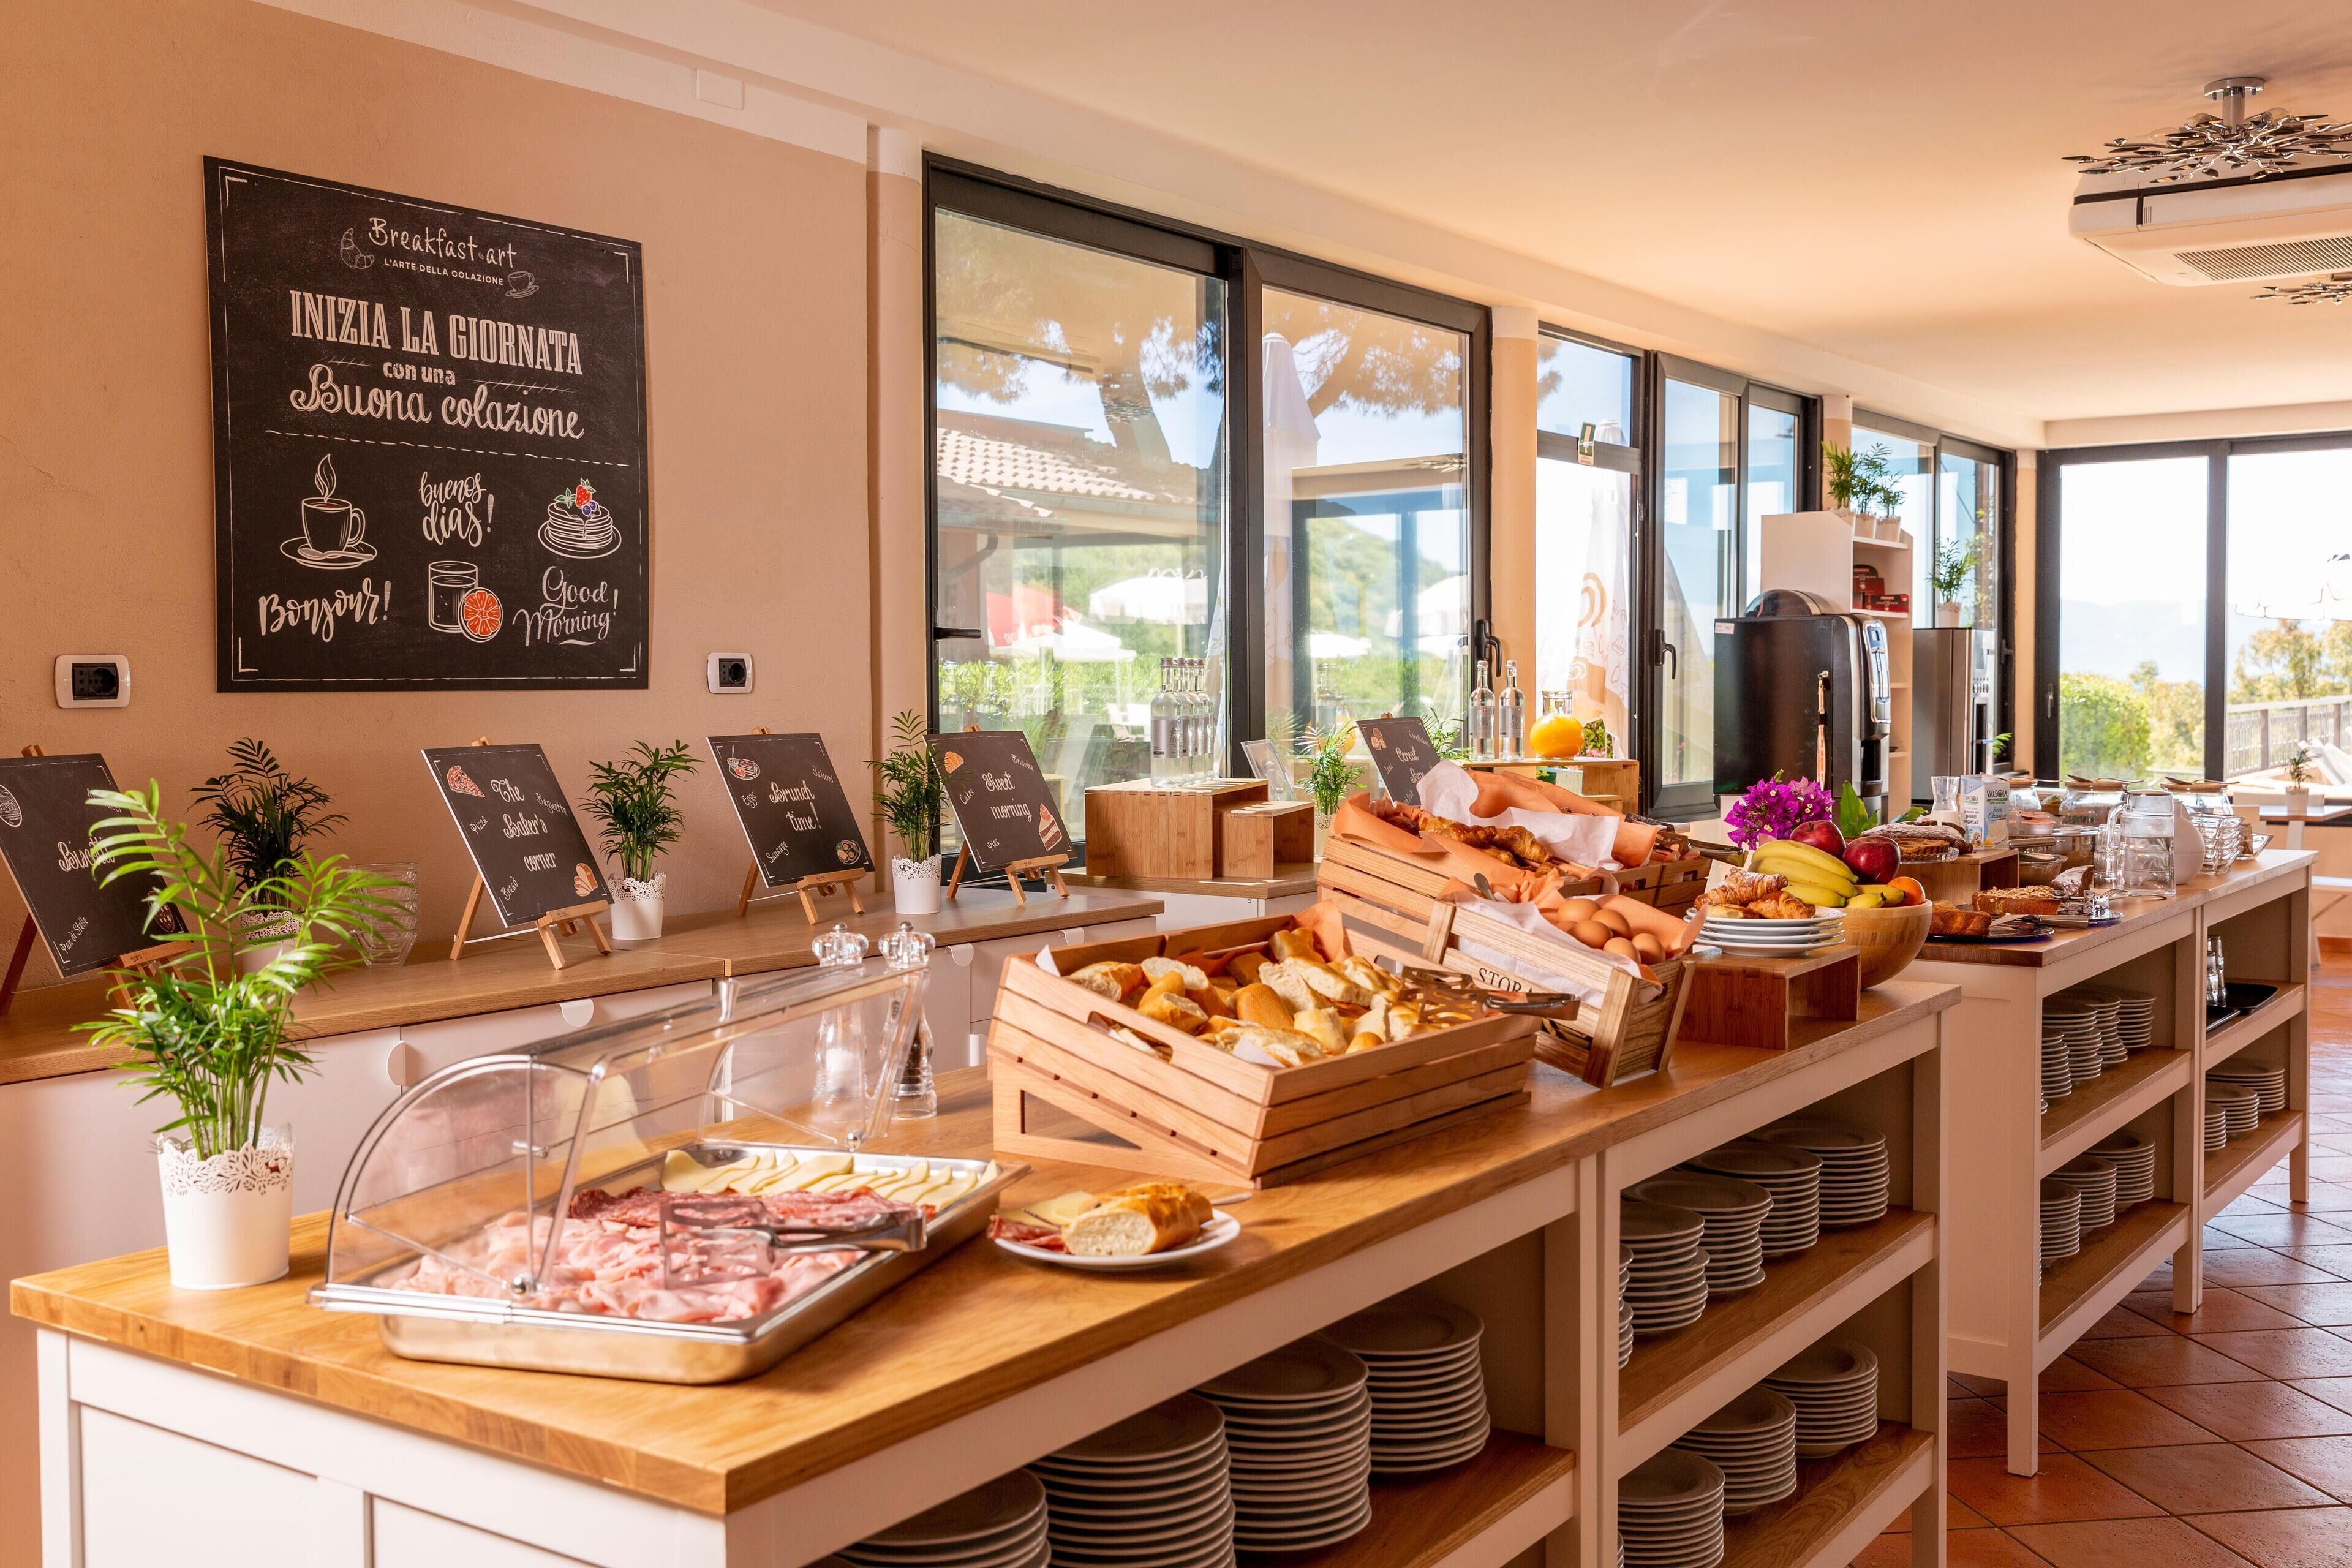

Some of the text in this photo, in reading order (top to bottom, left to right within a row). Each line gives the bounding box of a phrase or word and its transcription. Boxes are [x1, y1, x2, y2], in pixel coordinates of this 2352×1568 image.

[369, 217, 517, 268] Breakfast art
[384, 258, 504, 286] L'ARTE DELLA COLAZIONE
[290, 290, 582, 375] INIZIA LA GIORNATA
[383, 360, 456, 386] con una
[290, 364, 584, 439] Buona colazione
[418, 471, 487, 507] buenos
[540, 565, 609, 610] Good
[258, 577, 392, 643] Bonjour!
[812, 766, 834, 783] Salumi
[982, 772, 1015, 791] Sweet
[491, 778, 525, 802] The
[741, 791, 758, 809] Eggs
[769, 780, 815, 804] Brunch
[960, 788, 976, 805] Cakes
[535, 793, 568, 816] Baguette
[786, 802, 821, 831] time!
[990, 798, 1033, 823] morning
[470, 816, 489, 835] Pizza
[503, 812, 548, 839] Baker's
[766, 840, 790, 864] Sausage
[987, 838, 1000, 851] Pies
[524, 852, 557, 872] corner
[500, 876, 519, 900] Bread
[73, 916, 89, 935] Stelle
